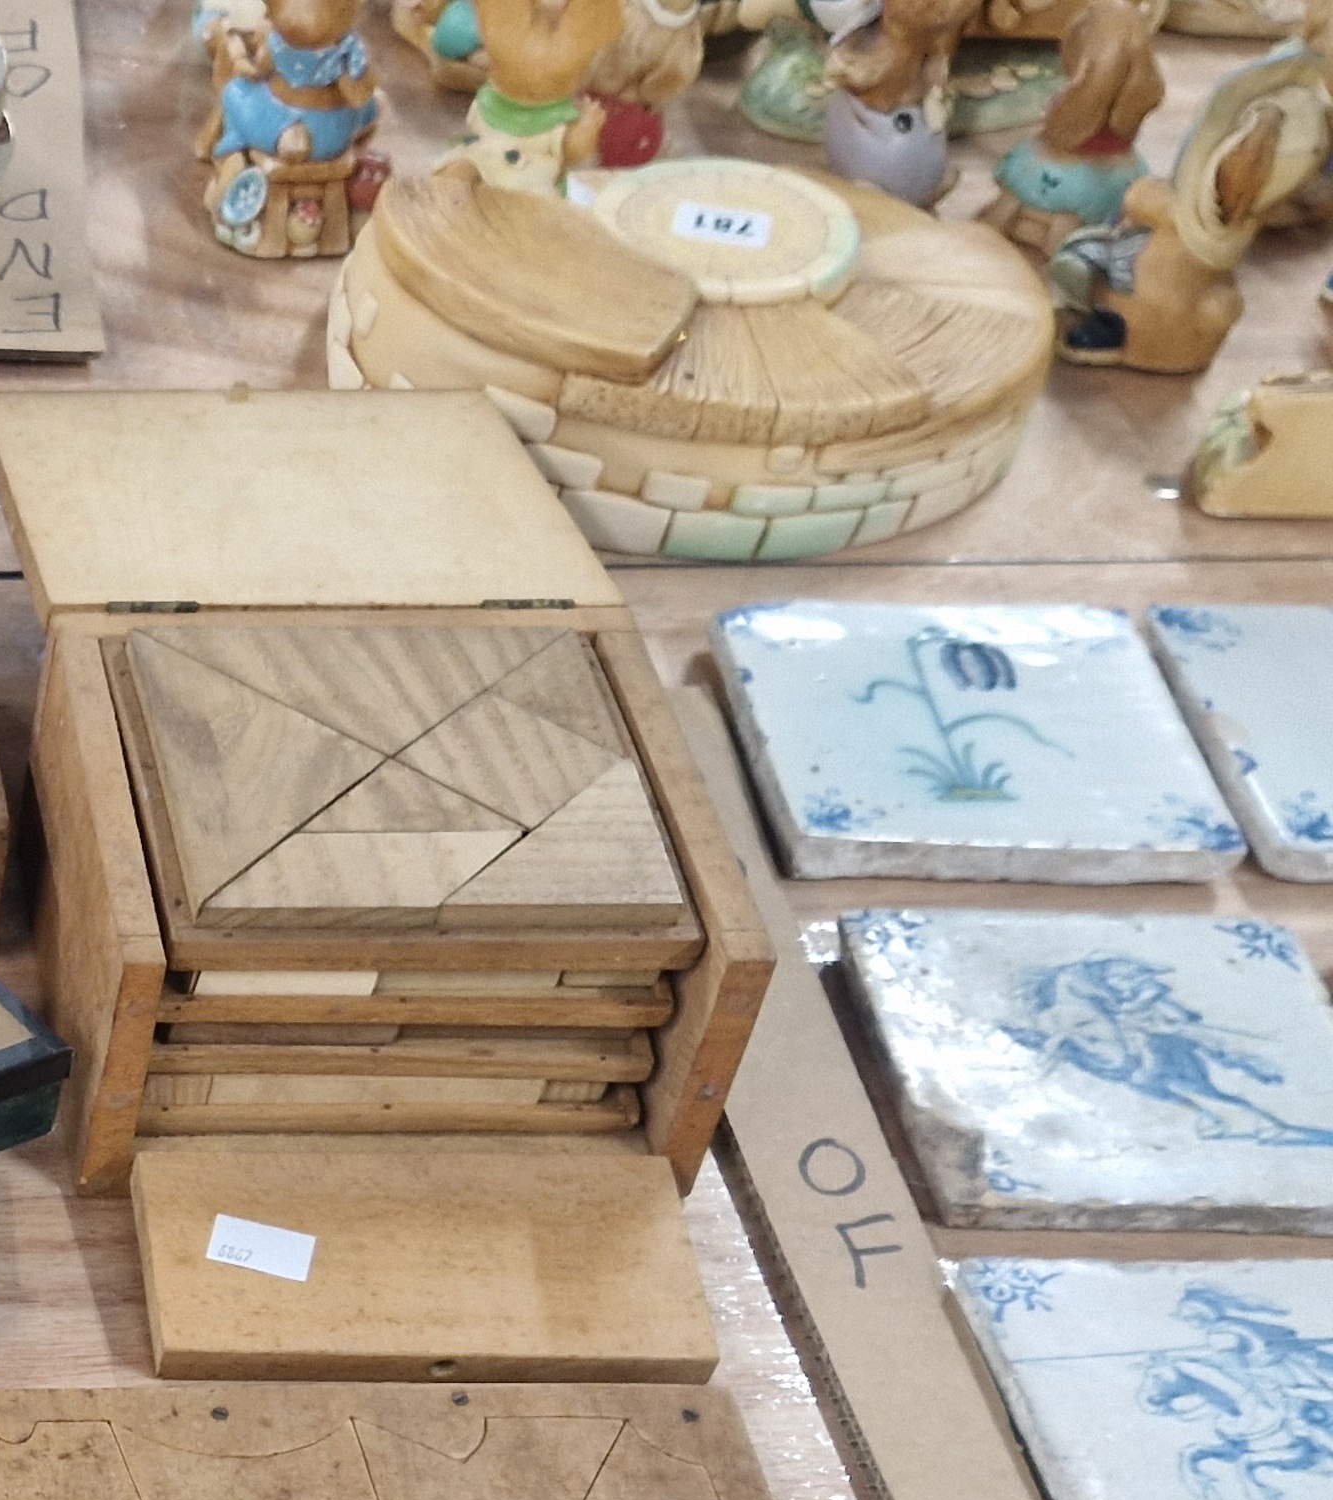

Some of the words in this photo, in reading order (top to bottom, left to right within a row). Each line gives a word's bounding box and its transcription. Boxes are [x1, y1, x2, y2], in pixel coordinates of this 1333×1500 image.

[0, 18, 53, 98] OF
[217, 1243, 254, 1263] 6867
[797, 1137, 903, 1289] OF
